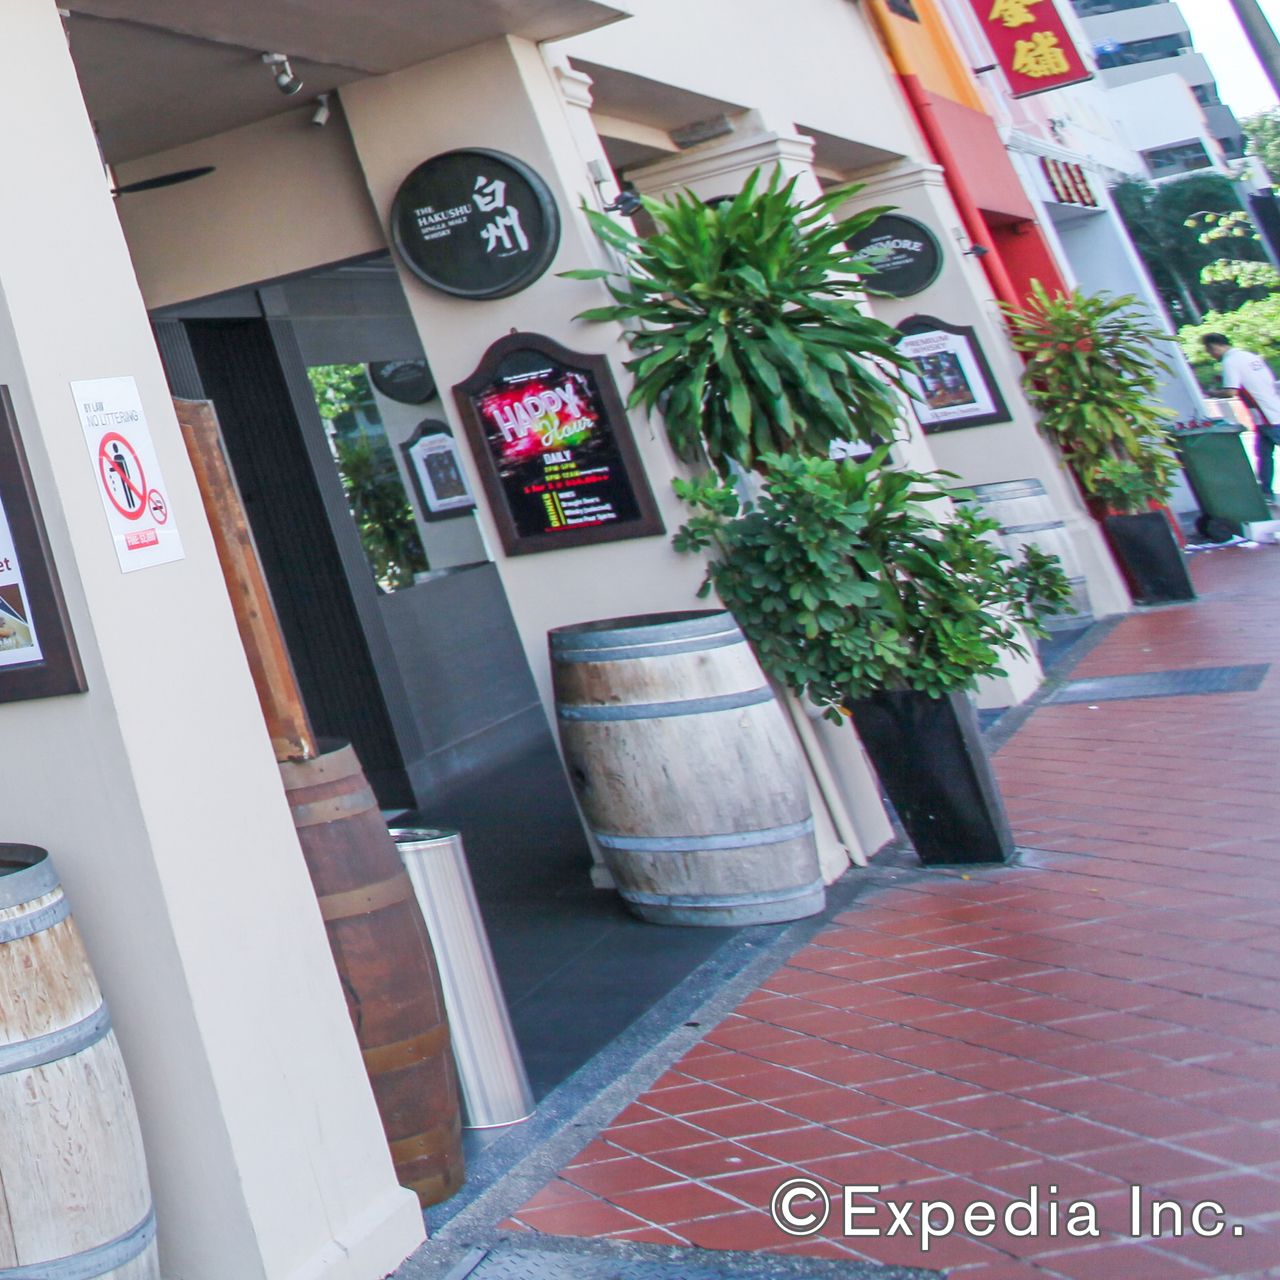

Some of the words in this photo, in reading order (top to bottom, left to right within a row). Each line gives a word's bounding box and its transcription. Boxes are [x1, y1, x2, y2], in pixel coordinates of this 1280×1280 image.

[415, 205, 435, 216] THE
[417, 204, 472, 227] HAKUSHU
[86, 414, 100, 427] NO
[100, 410, 139, 426] LITTERING
[491, 383, 582, 442] HAPPY
[543, 450, 572, 464] DAILY
